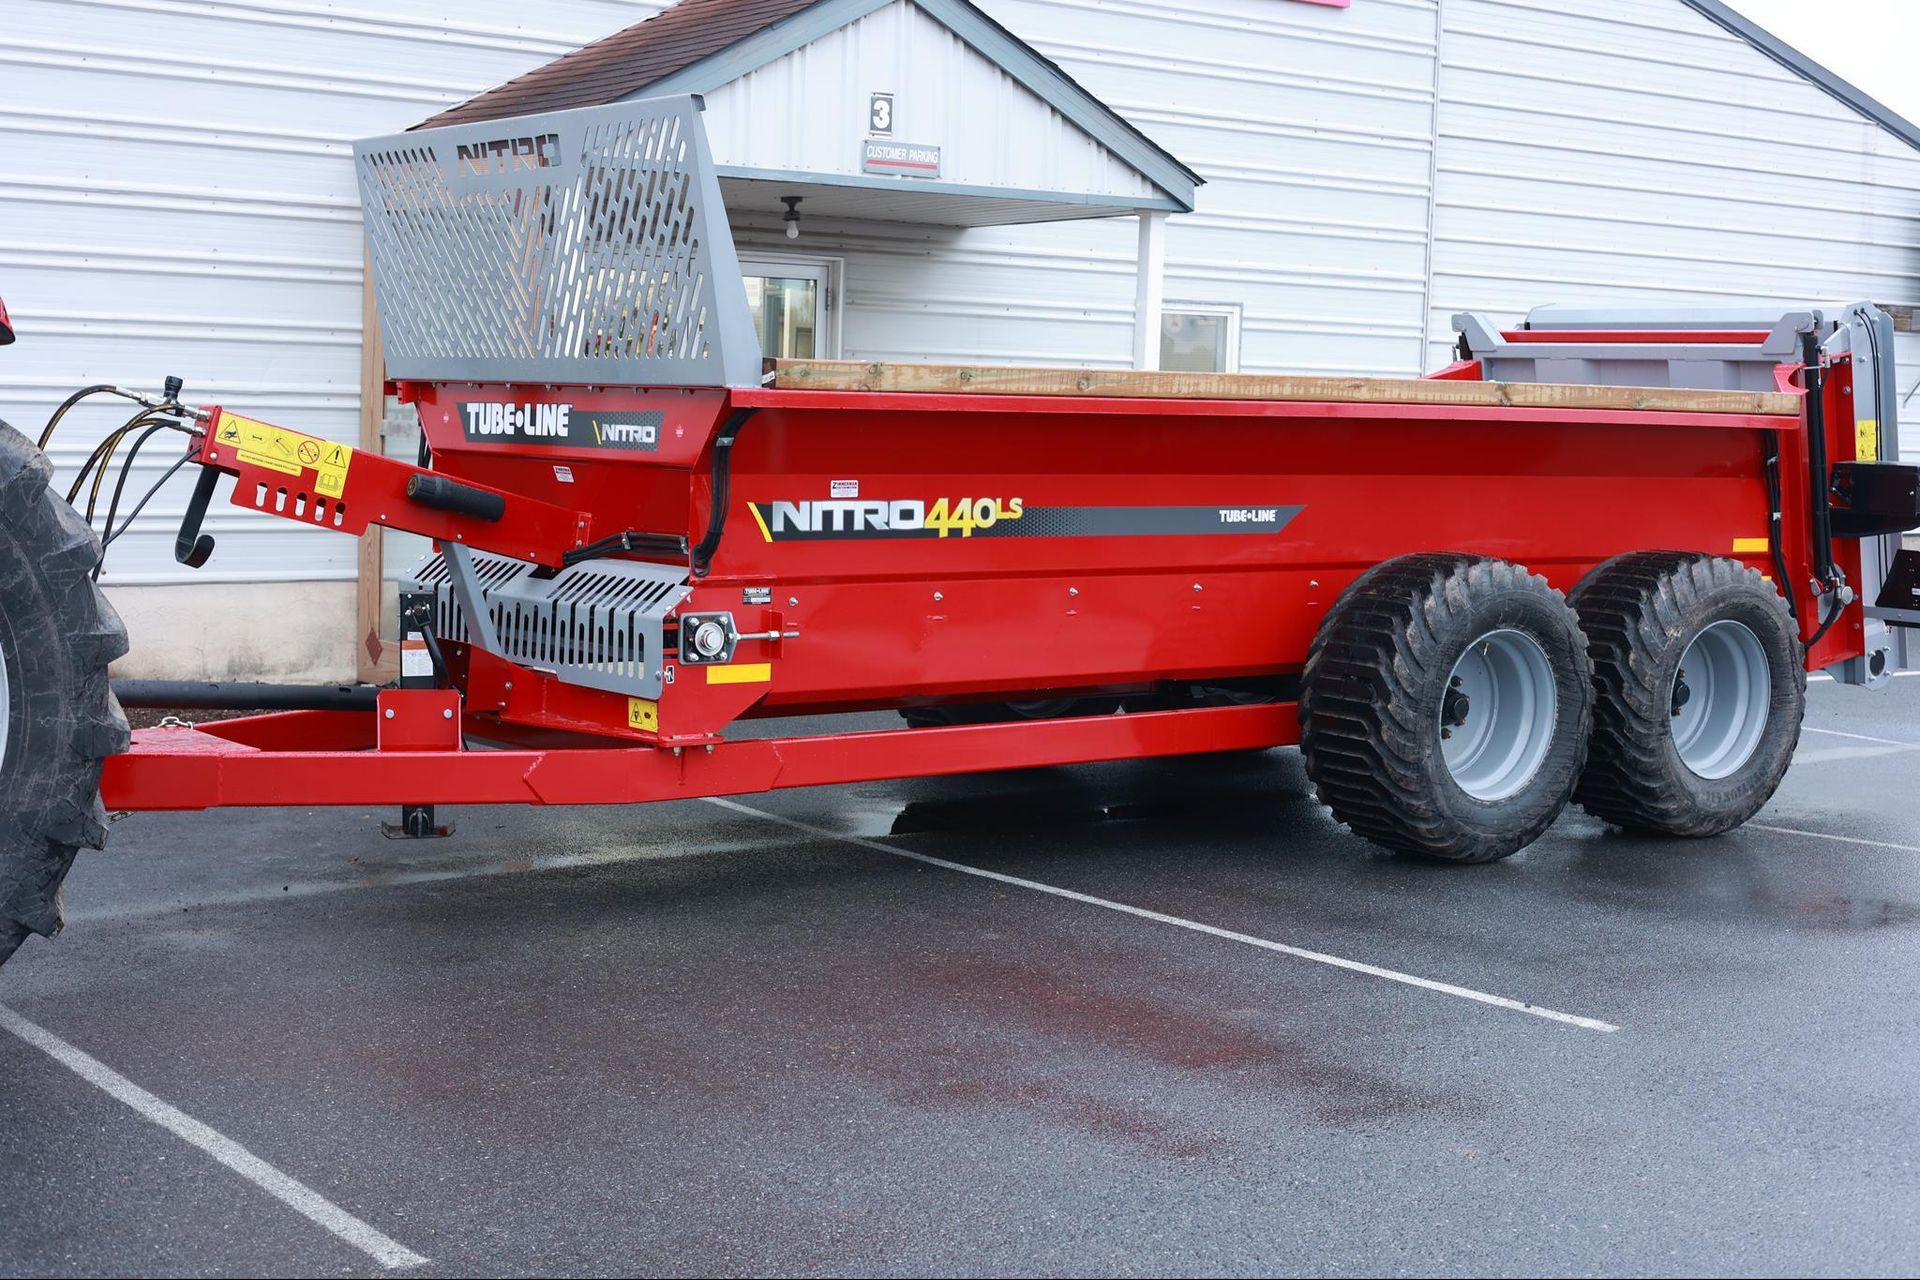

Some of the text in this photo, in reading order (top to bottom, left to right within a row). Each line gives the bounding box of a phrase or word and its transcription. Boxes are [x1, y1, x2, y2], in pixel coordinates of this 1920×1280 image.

[873, 100, 890, 129] 3
[456, 134, 562, 176] NITRO
[866, 145, 939, 164] CUSTOMER PARKING
[601, 424, 656, 444] NITRO
[772, 500, 925, 532] NITRO
